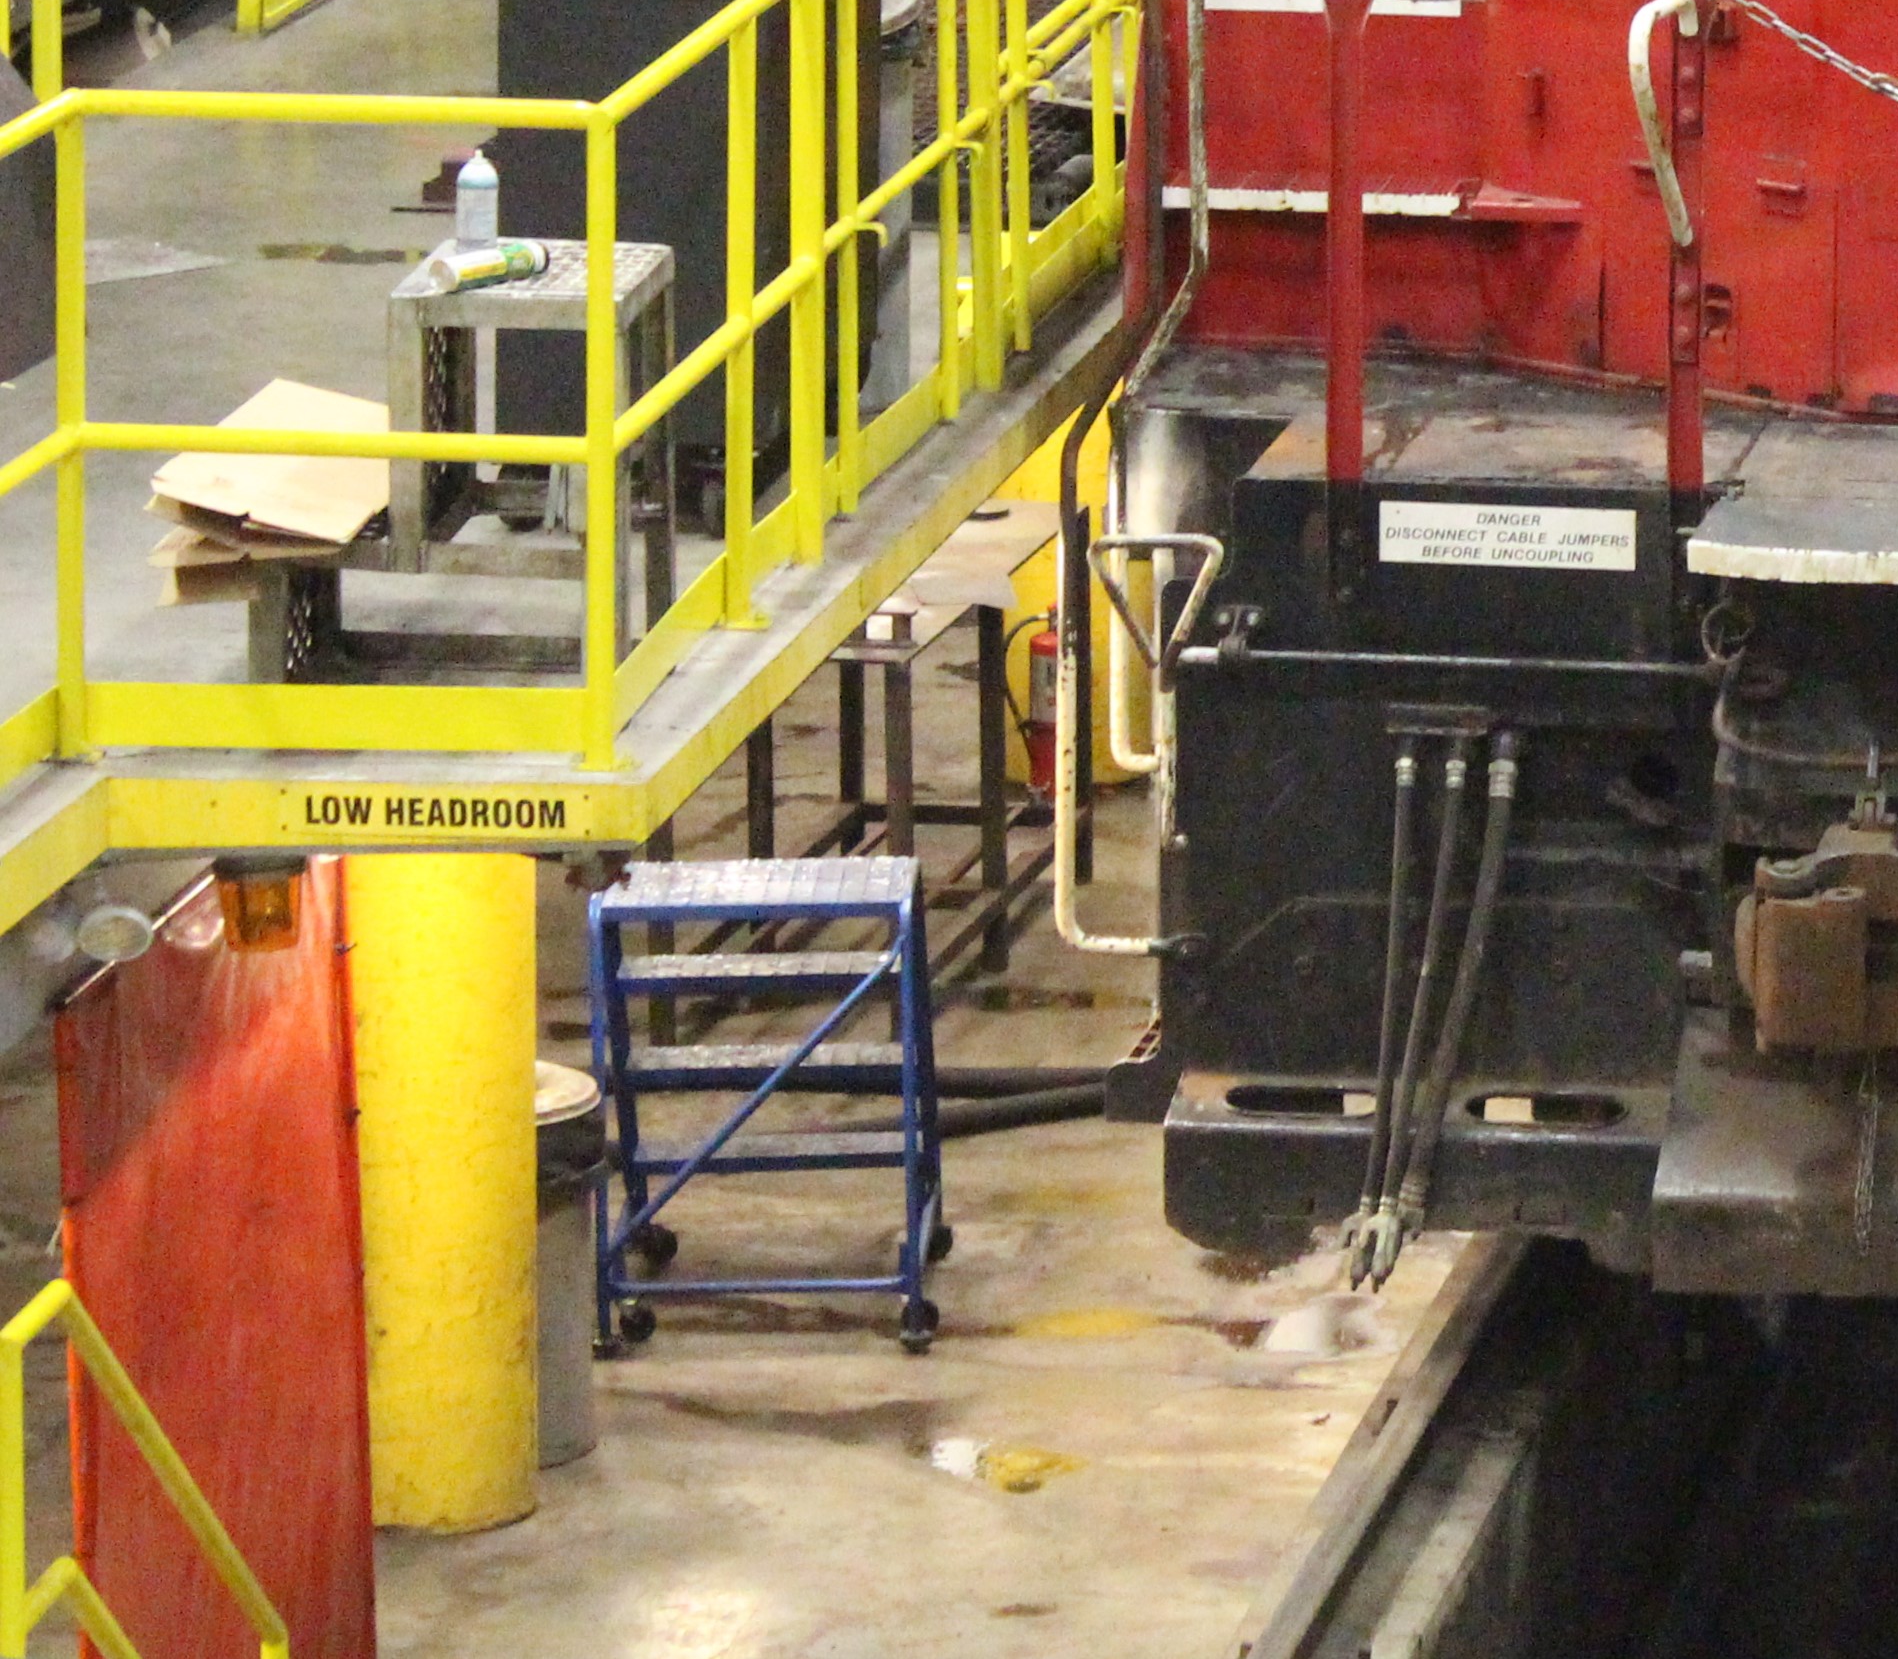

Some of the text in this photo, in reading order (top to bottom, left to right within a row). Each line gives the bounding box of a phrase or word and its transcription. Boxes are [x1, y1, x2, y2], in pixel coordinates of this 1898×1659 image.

[1476, 512, 1541, 526] DANGER
[1385, 527, 1629, 547] DISCONNECT CABLE JUMPERS
[1421, 546, 1594, 563] BEFORE UNCOUPLING
[306, 795, 566, 828] LOW HEADROOM
